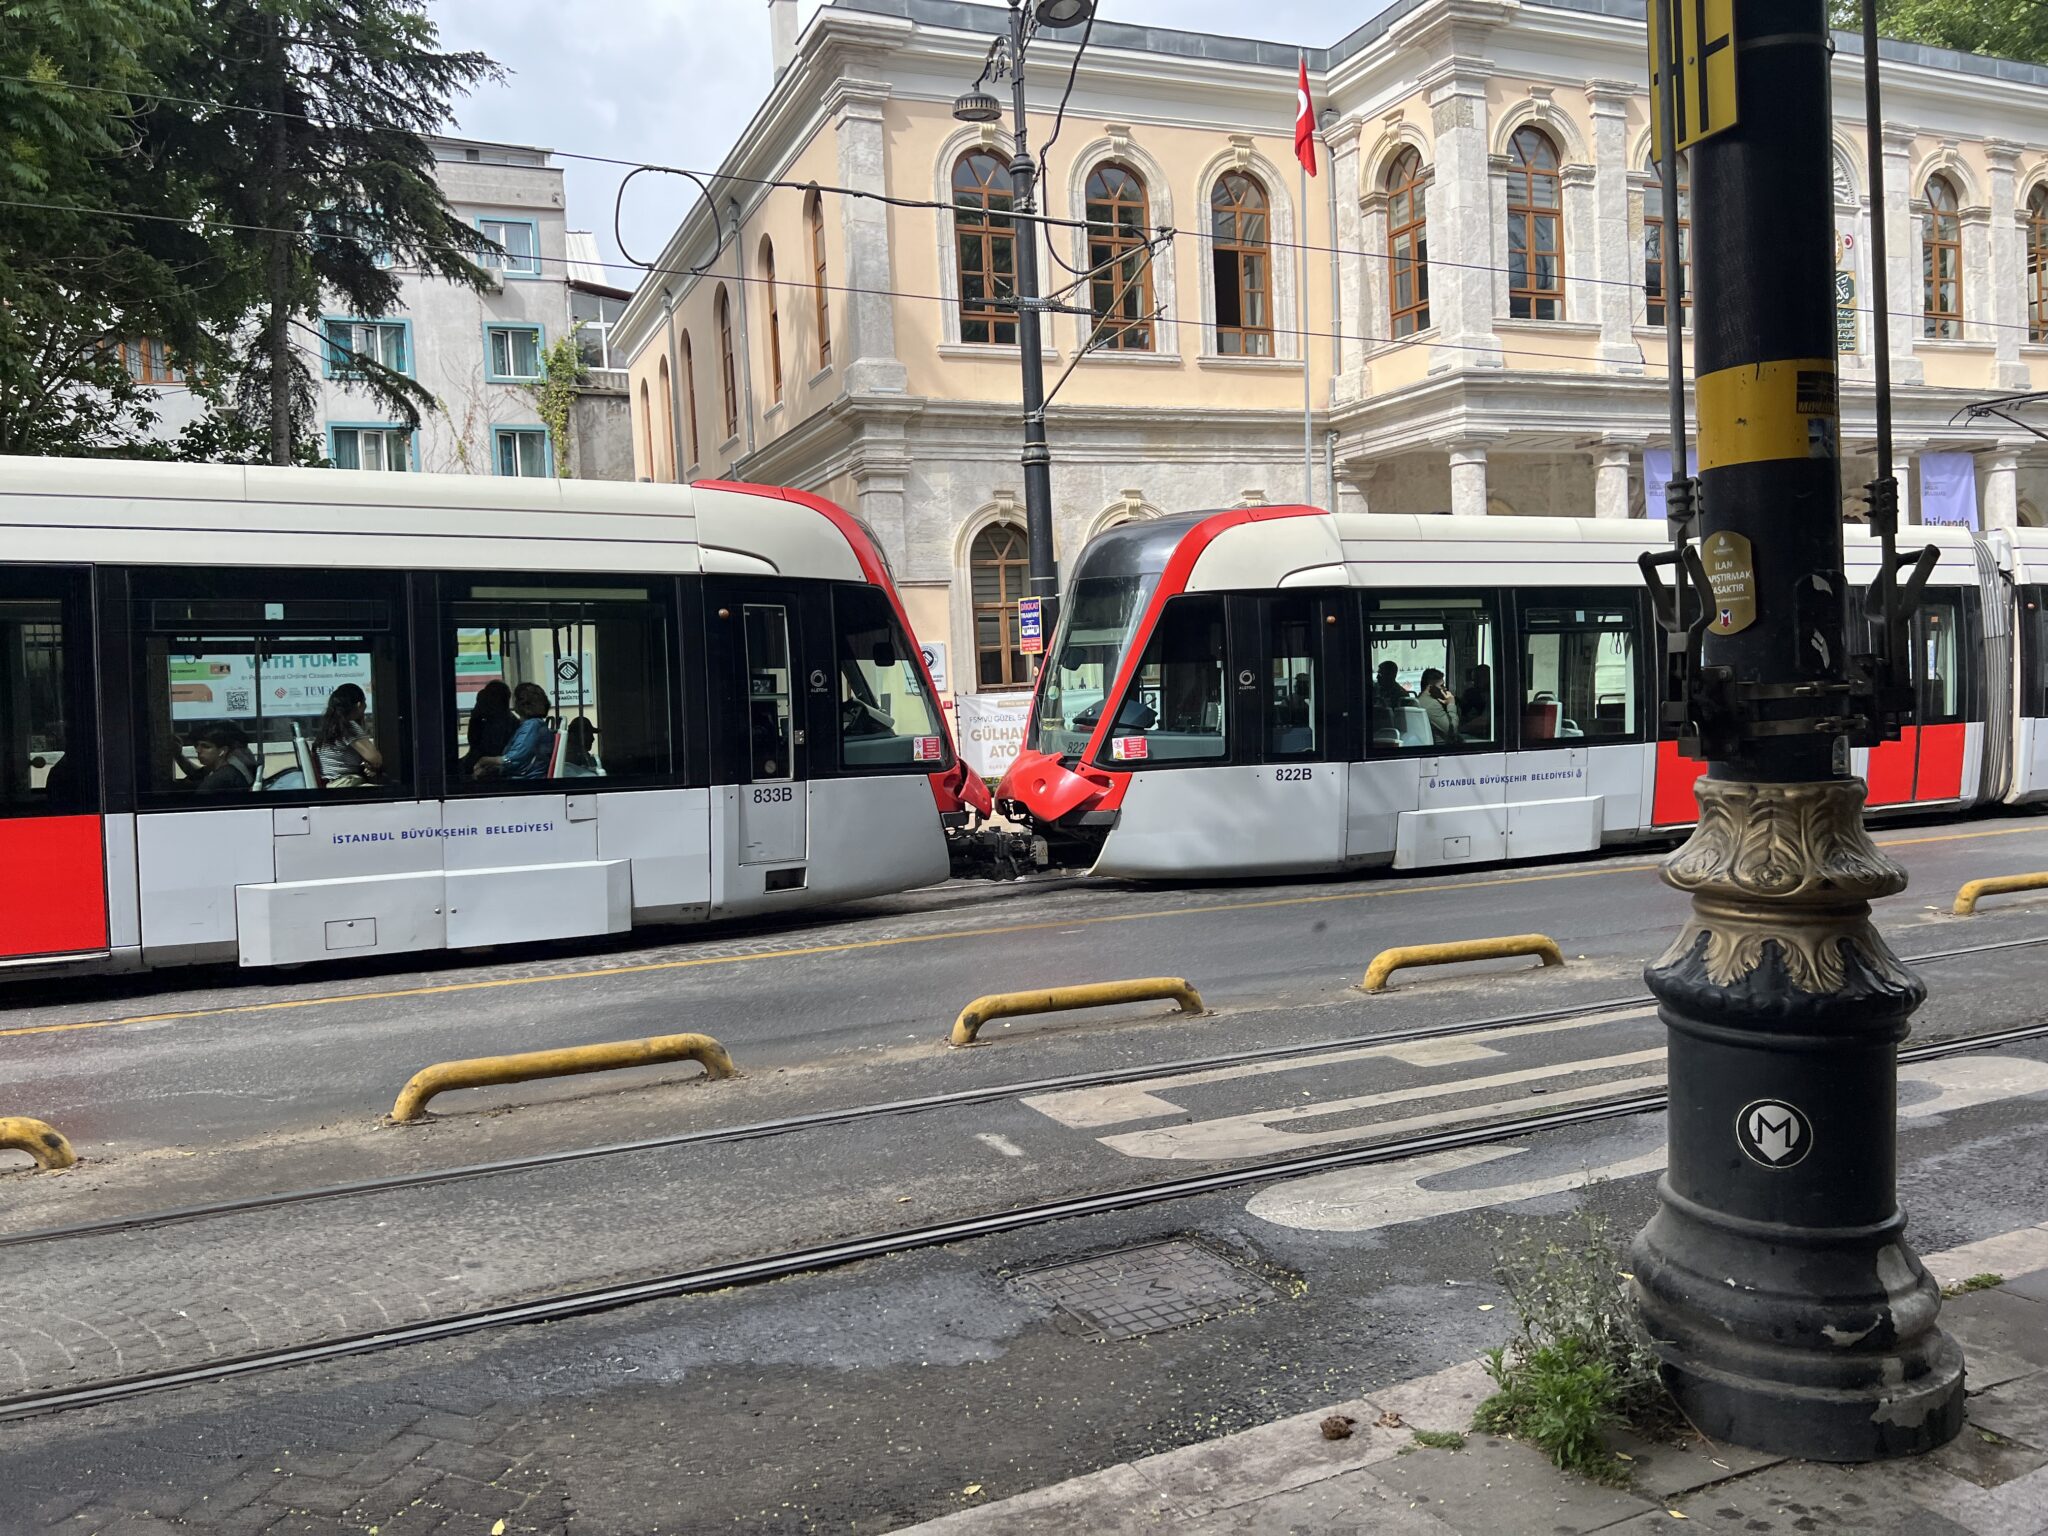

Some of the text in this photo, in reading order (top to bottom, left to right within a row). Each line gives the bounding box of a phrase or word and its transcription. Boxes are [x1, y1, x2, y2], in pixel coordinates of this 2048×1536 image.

[1707, 570, 1751, 584] APIŞTIRMAK
[1712, 584, 1744, 594] ASAKTIR
[299, 654, 359, 667] TUMER
[989, 741, 1021, 758] ATÖ
[1276, 768, 1312, 781] 822B
[1480, 774, 1527, 785] BÜYÜKŞEHİR
[1531, 770, 1574, 781] BELEDİYESİ
[753, 787, 792, 804] 833B
[332, 822, 553, 844] İSTANBUL BÜYÜKŞEHİR BELEDİYESİ
